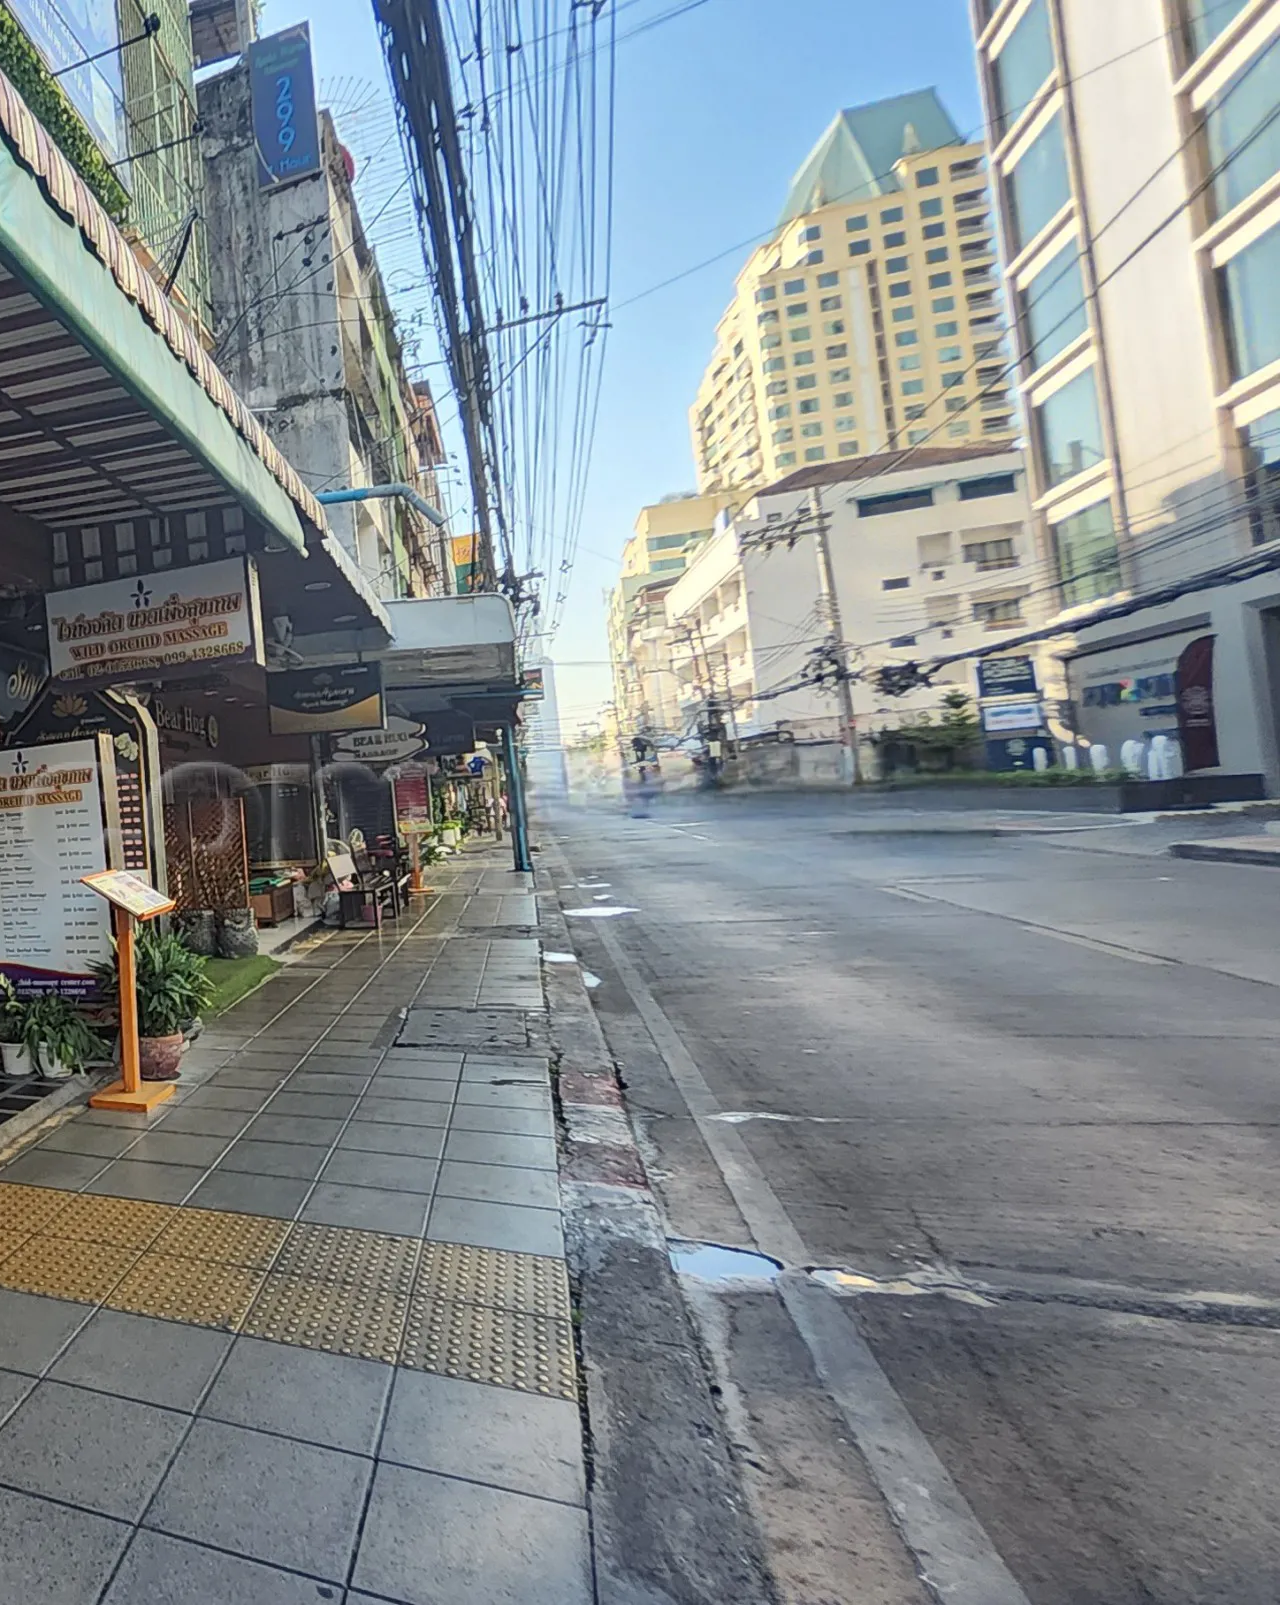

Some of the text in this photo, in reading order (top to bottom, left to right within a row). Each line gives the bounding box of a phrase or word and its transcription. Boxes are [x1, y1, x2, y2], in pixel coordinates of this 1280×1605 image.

[275, 76, 296, 153] 299
[70, 622, 228, 660] WILD ORCHID MASSAGE
[155, 699, 206, 740] Bear Hug
[36, 790, 82, 805] MASSAGE
